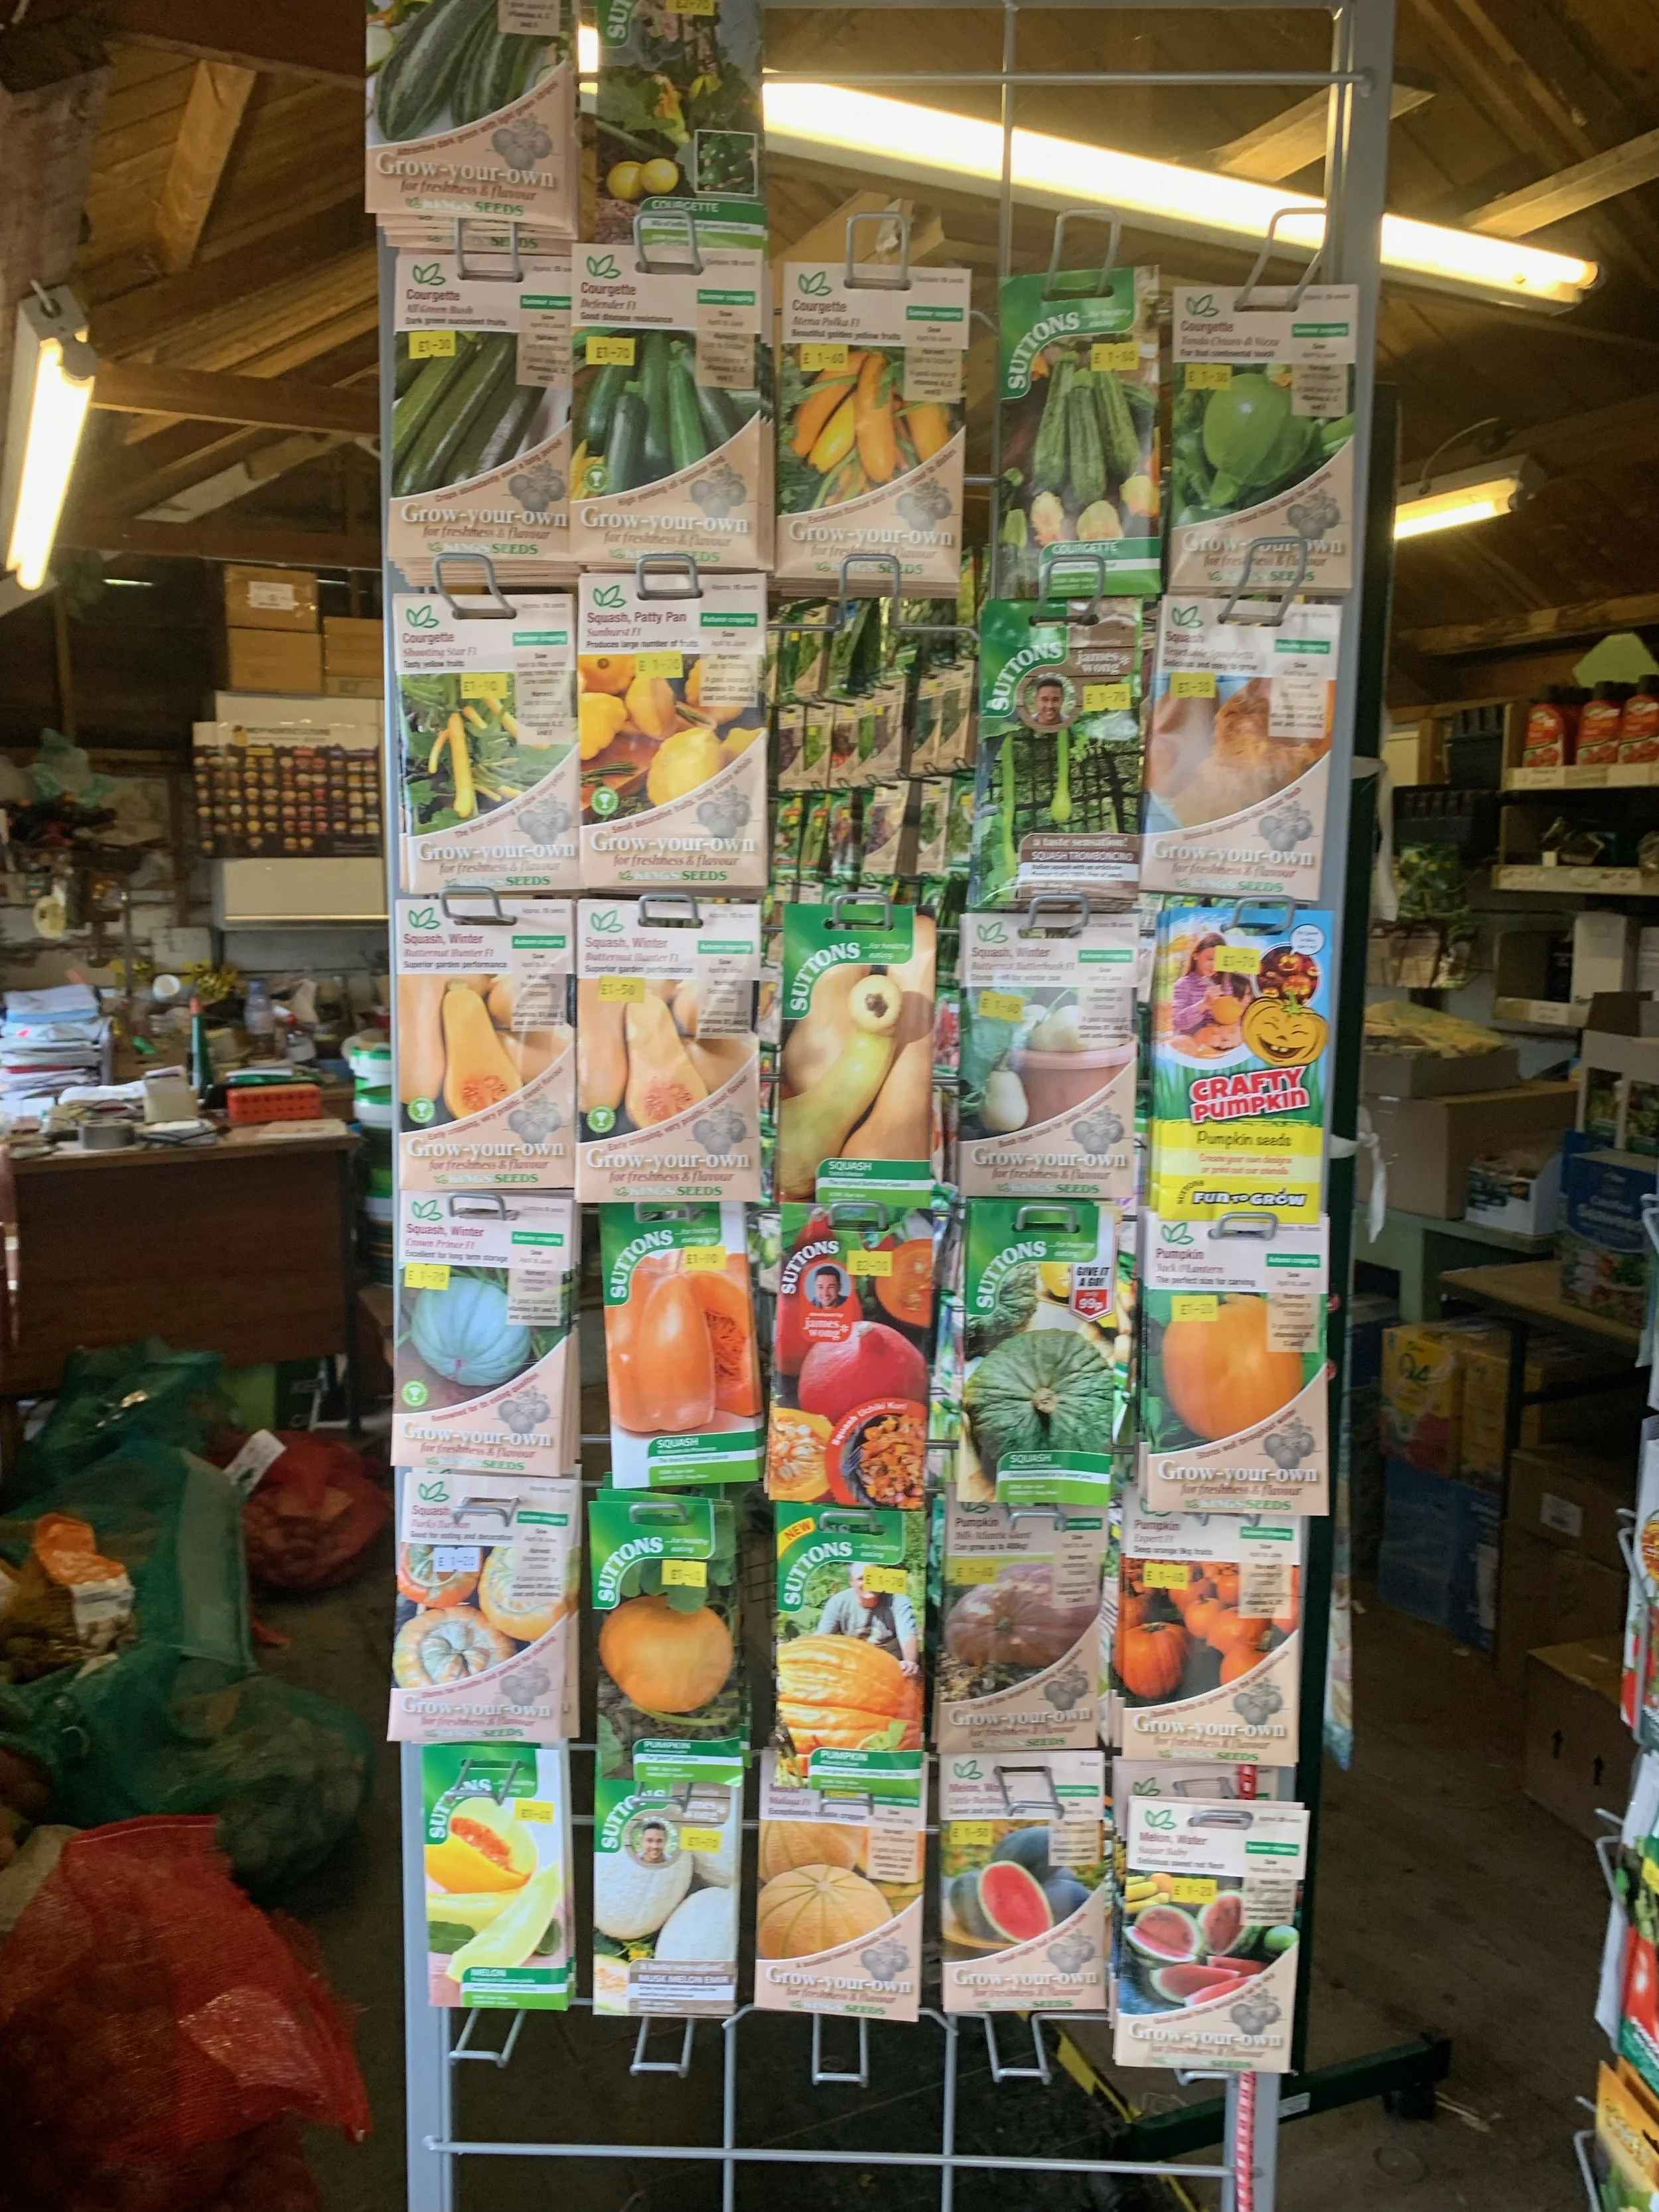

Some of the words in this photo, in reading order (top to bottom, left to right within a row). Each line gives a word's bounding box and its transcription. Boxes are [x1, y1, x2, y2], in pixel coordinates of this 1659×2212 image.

[376, 151, 555, 187] Grow-your-own
[652, 200, 719, 214] COURGETTE
[406, 289, 461, 308] Courgette
[581, 282, 636, 302] Courgette
[792, 299, 847, 313] Courgette
[1181, 321, 1234, 334] Courgette
[1007, 311, 1080, 390] SUTTONS
[401, 503, 568, 527] Grow-your-own
[579, 506, 750, 534] Grow-your-own
[788, 520, 952, 547] Grow-your-own
[490, 543, 539, 555] SEEDS
[587, 612, 632, 624] Squash,
[634, 611, 662, 625] Patty
[666, 612, 687, 623] Pan
[402, 632, 455, 644] Courgette
[992, 641, 1064, 711] SUTTONS
[416, 840, 577, 861] Grow-your-own
[591, 830, 756, 854] Grow-your-own
[1031, 851, 1068, 861] SQUASH
[1152, 839, 1315, 866] Grow-your-own
[403, 934, 446, 945] Squash,
[449, 933, 483, 944] Winter
[585, 937, 629, 949] Squash,
[632, 937, 668, 948] Winter
[971, 947, 1013, 958] Squash,
[1016, 946, 1051, 958] Winter
[403, 960, 433, 969] Superior
[435, 961, 460, 970] garden
[462, 961, 508, 970] performance
[584, 964, 616, 974] Superior
[618, 965, 644, 974] garden
[644, 966, 693, 974] performance
[790, 942, 861, 1011] SUTTONS
[1190, 1067, 1306, 1102] CRAFTY
[1196, 1130, 1254, 1145] Pumpkin
[1255, 1133, 1292, 1147] seeds
[407, 1137, 565, 1159] Grow-your-own
[971, 1146, 1127, 1167] Grow-your-own
[447, 1159, 496, 1171] freshness
[508, 1159, 549, 1171] flavour
[586, 1148, 751, 1171] Grow-your-own
[828, 1161, 873, 1171] SQUASH
[494, 1173, 539, 1183] SEEDS
[1193, 1190, 1230, 1205] FUN
[1250, 1187, 1307, 1207] GROW
[406, 1224, 447, 1236] Squash,
[450, 1226, 484, 1238] Winter
[448, 1252, 463, 1261] long
[1156, 1248, 1204, 1260] Pumpkin
[611, 1230, 674, 1298] SUTTONS
[780, 1240, 840, 1295] SUTTONS
[1076, 1266, 1097, 1276] GIVE
[977, 1241, 1048, 1308] SUTTONS
[1078, 1297, 1104, 1311] 99p
[401, 1420, 552, 1447] Grow-your-own
[656, 1438, 699, 1447] SQUASH
[1009, 1454, 1052, 1463] SQUASH
[1157, 1459, 1318, 1483] Grow-your-own
[783, 1520, 813, 1540] NEW
[955, 1517, 999, 1528] Pumpkin
[1133, 1519, 1182, 1532] Pumpkin
[597, 1536, 664, 1602] SUTTONS
[783, 1541, 853, 1605] SUTTONS
[1133, 1714, 1285, 1737] Grow-your-own
[644, 1741, 691, 1749] PUMPKIN
[820, 1750, 869, 1761] PUMPKIN
[1139, 1832, 1175, 1844] Melon,
[1177, 1834, 1208, 1846] Water
[471, 1968, 506, 1977] MELON
[765, 1965, 913, 1994] Grow-your-own
[1129, 2021, 1281, 2047] Grow-your-own
